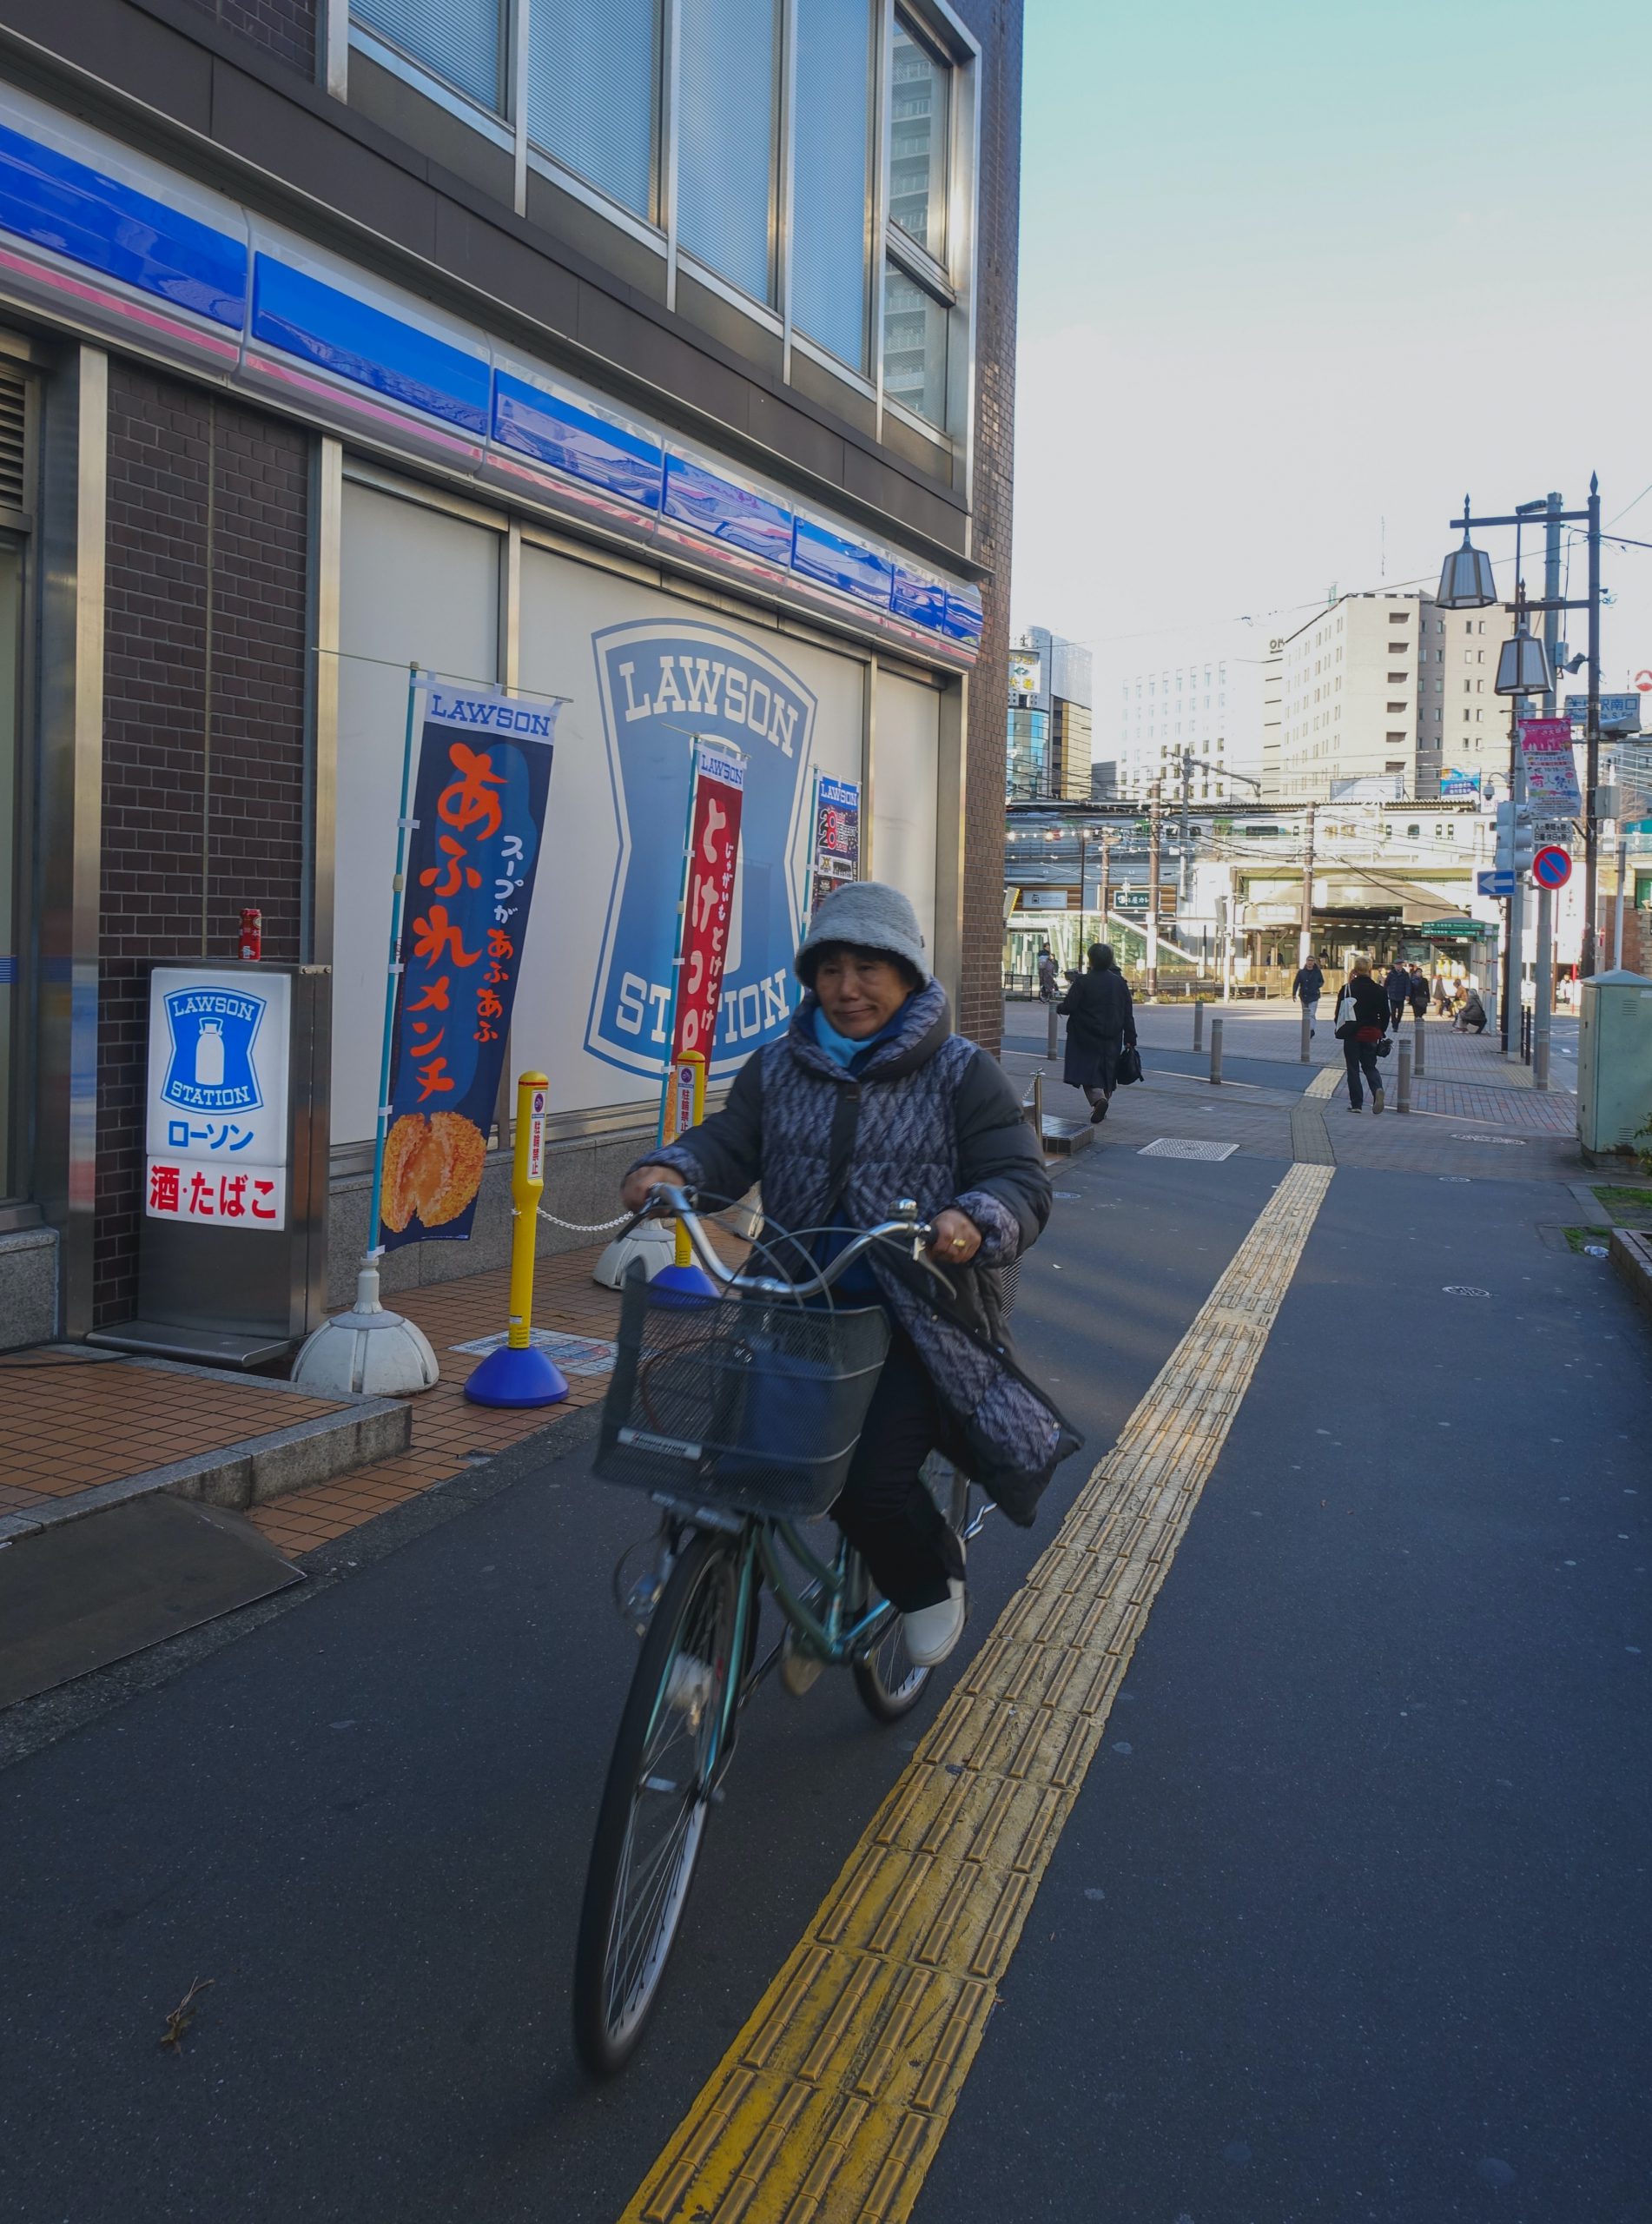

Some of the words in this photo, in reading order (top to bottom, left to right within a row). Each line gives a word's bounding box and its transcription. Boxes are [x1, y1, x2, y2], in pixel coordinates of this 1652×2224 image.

[431, 695, 551, 737] LAWSON
[619, 655, 798, 758] LAWSON
[701, 753, 743, 784] LAWSON
[821, 784, 857, 806] LAWSON
[406, 742, 508, 1102] あふれメンチ
[173, 996, 255, 1022] LAWSON
[616, 968, 790, 1046] STION
[171, 1080, 251, 1106] STATION
[169, 1120, 254, 1151] ローソン
[149, 1164, 276, 1219] 酒・たばこ
